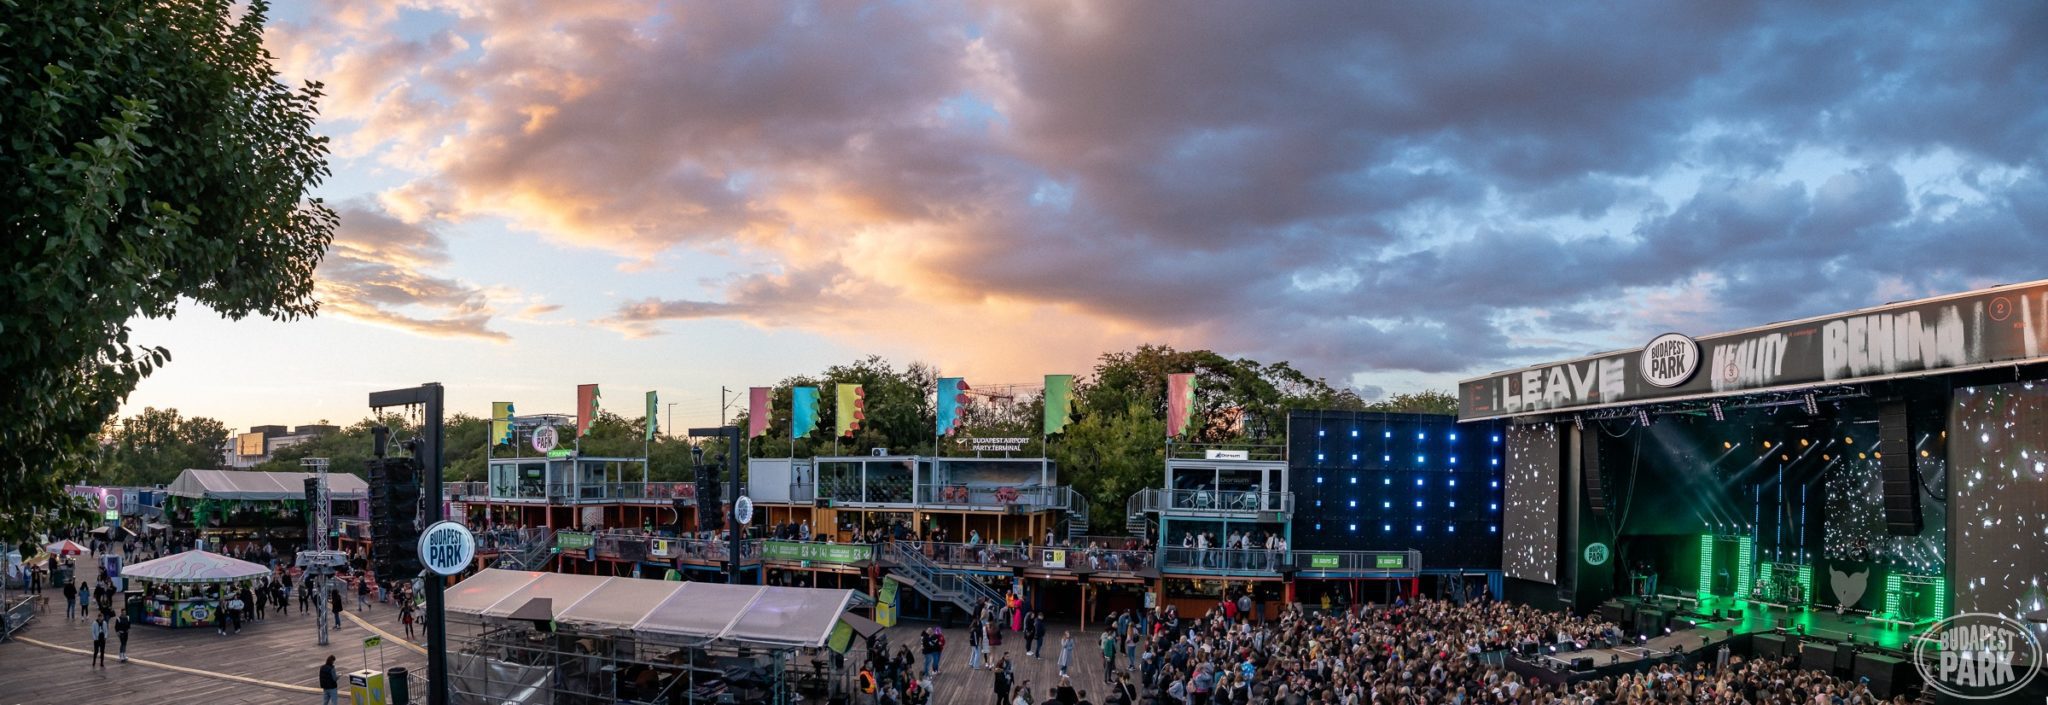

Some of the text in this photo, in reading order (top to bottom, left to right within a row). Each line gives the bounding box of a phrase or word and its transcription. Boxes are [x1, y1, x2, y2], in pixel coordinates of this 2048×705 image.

[1651, 341, 1686, 359] BUDAPEST
[1651, 354, 1686, 379] PARK
[1502, 357, 1625, 413] LEAVE
[991, 444, 1021, 452] TERMINAL
[430, 528, 462, 545] BUDAPEST
[430, 545, 462, 568] PARK
